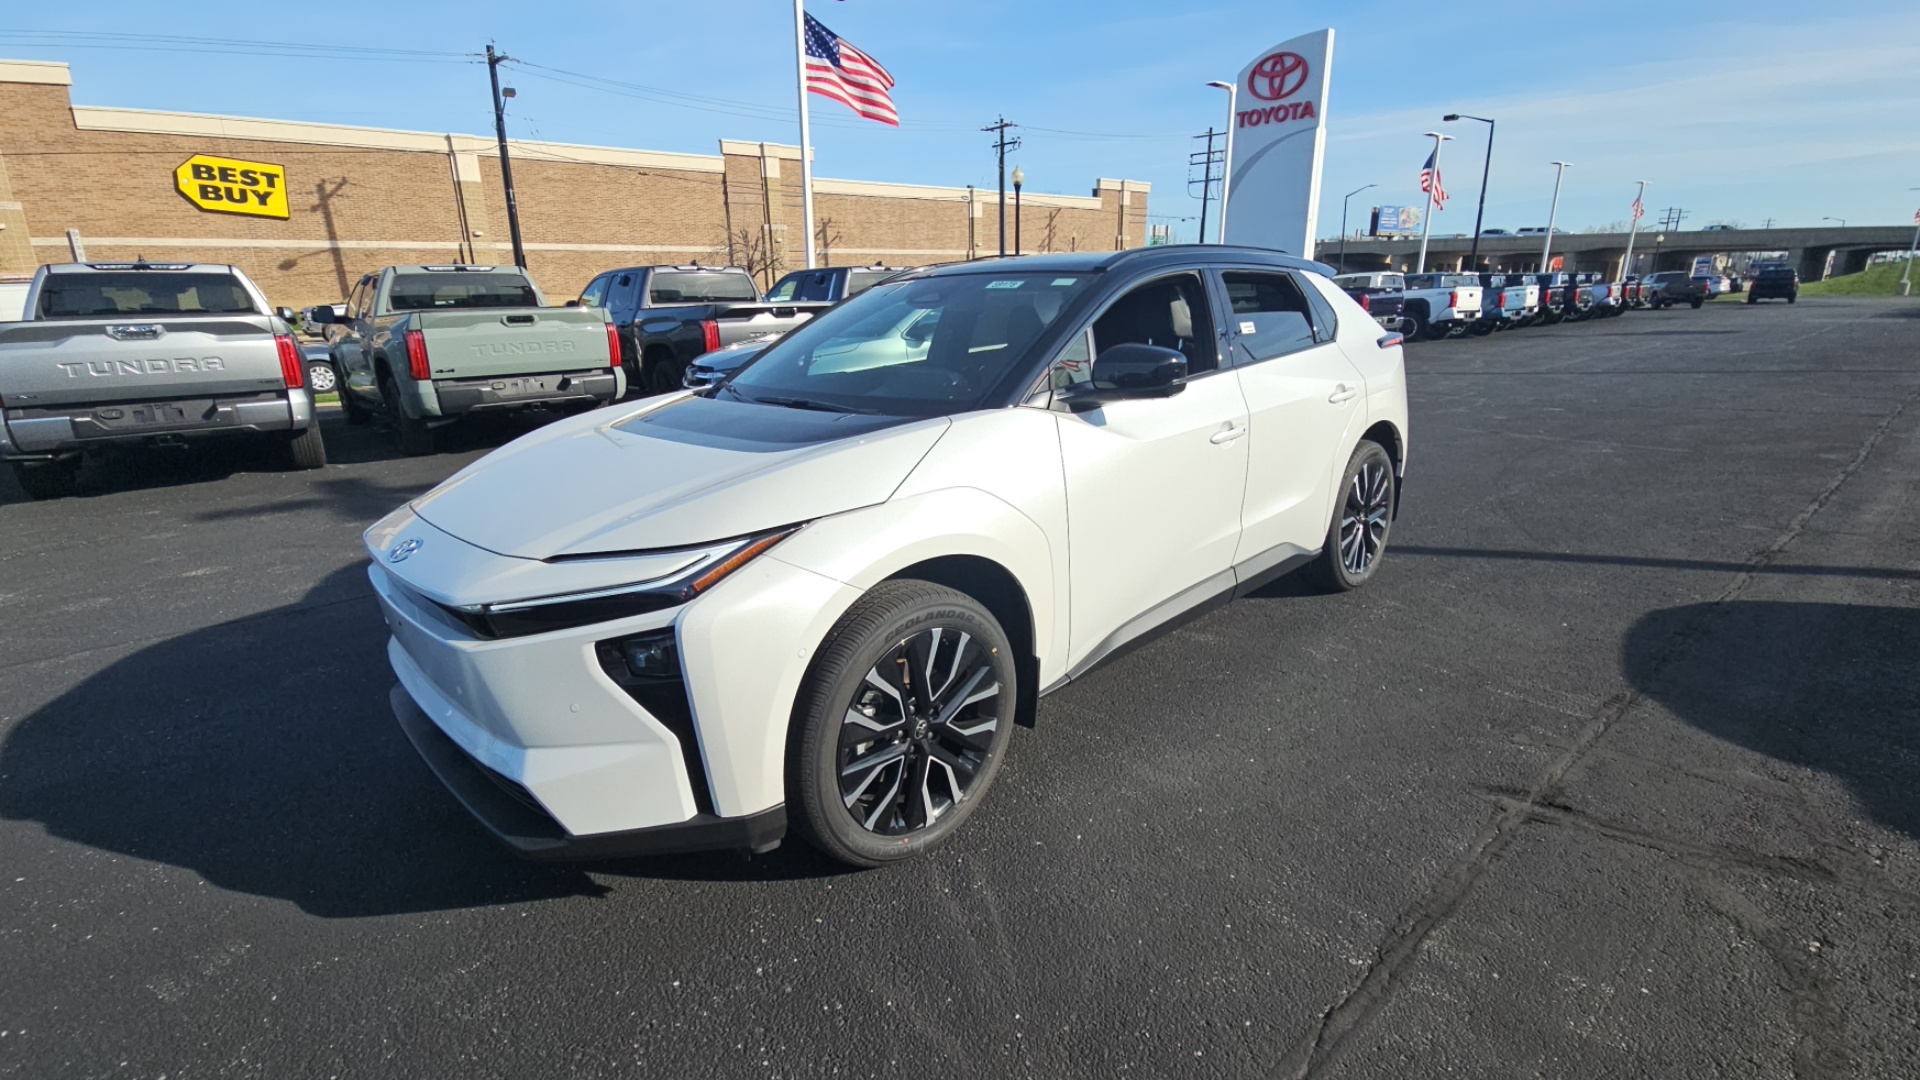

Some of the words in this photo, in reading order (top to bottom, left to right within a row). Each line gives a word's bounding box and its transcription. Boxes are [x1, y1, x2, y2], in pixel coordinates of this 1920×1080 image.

[1236, 100, 1316, 129] TOYOTA
[190, 163, 281, 189] BEST
[198, 184, 275, 207] BUY
[470, 340, 576, 358] TUNDRA
[57, 355, 226, 379] TUNDRA
[884, 610, 975, 643] GEOLANDAR
